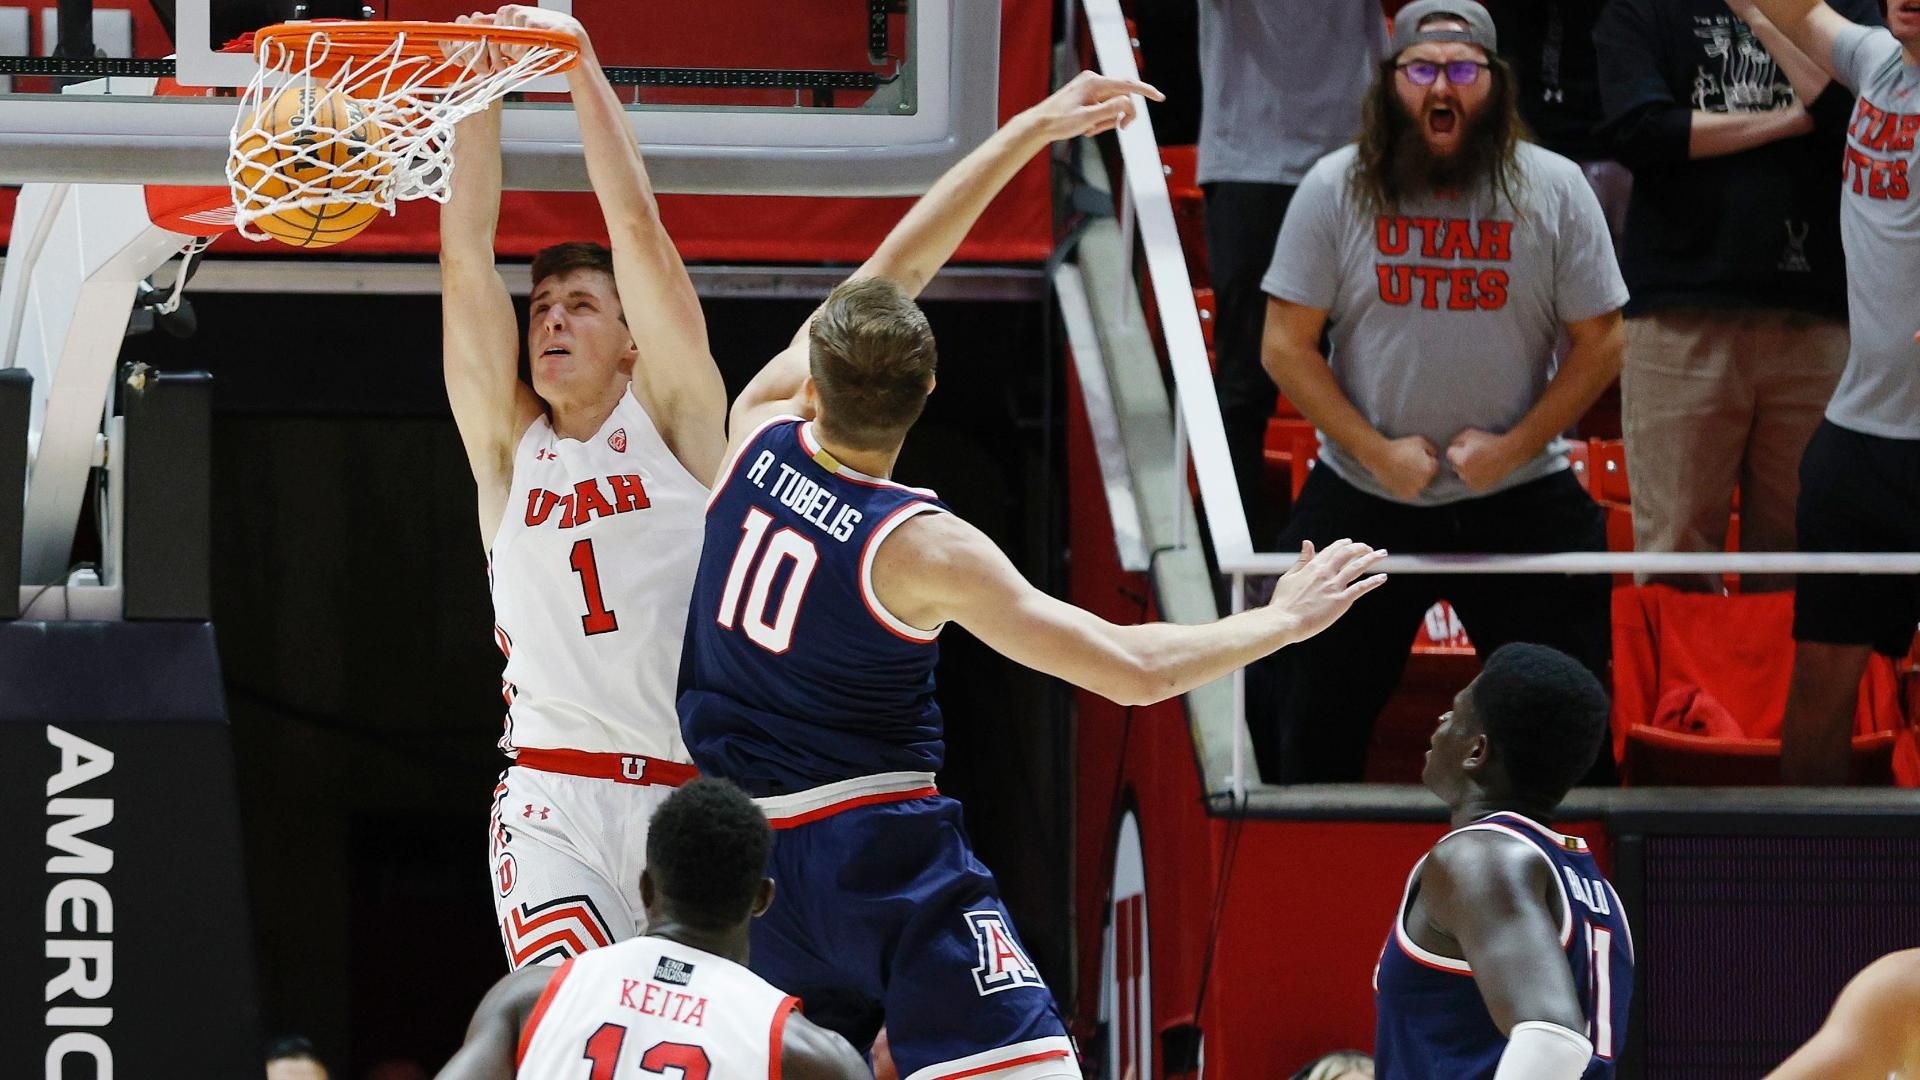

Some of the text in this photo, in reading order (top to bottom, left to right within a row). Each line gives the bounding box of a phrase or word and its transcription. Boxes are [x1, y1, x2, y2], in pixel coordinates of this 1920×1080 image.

[1850, 96, 1920, 152] TAH
[1376, 215, 1514, 261] UTAH
[1376, 263, 1510, 311] UTES
[524, 474, 651, 529] UTAH
[746, 449, 863, 543] A. TUBELIS
[569, 538, 619, 636] 1
[716, 505, 820, 656] 10
[621, 756, 647, 780] U
[45, 724, 115, 1080] AMERIC
[963, 910, 1046, 996] A
[619, 978, 709, 1027] KEITA
